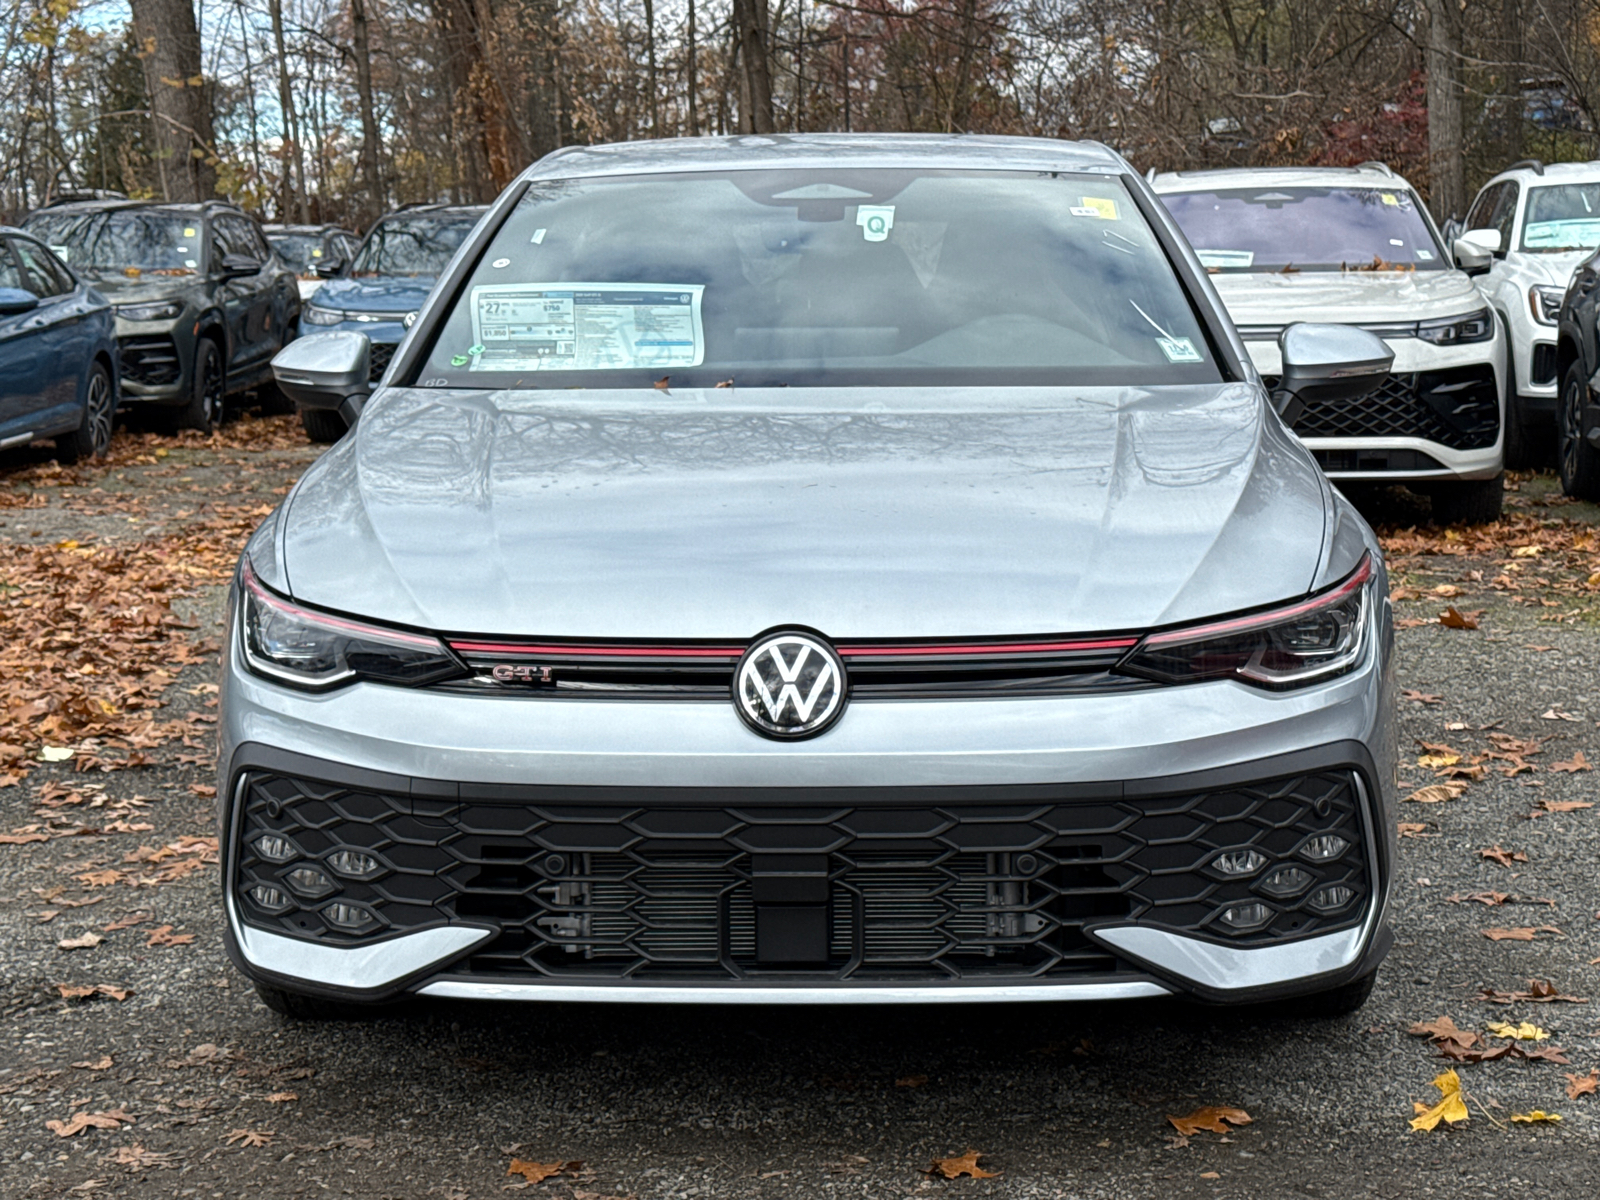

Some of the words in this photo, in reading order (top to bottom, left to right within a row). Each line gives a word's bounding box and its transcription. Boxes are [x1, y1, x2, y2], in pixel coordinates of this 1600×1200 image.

[867, 215, 885, 234] Q
[485, 303, 500, 314] 27
[492, 664, 553, 683] GTI
